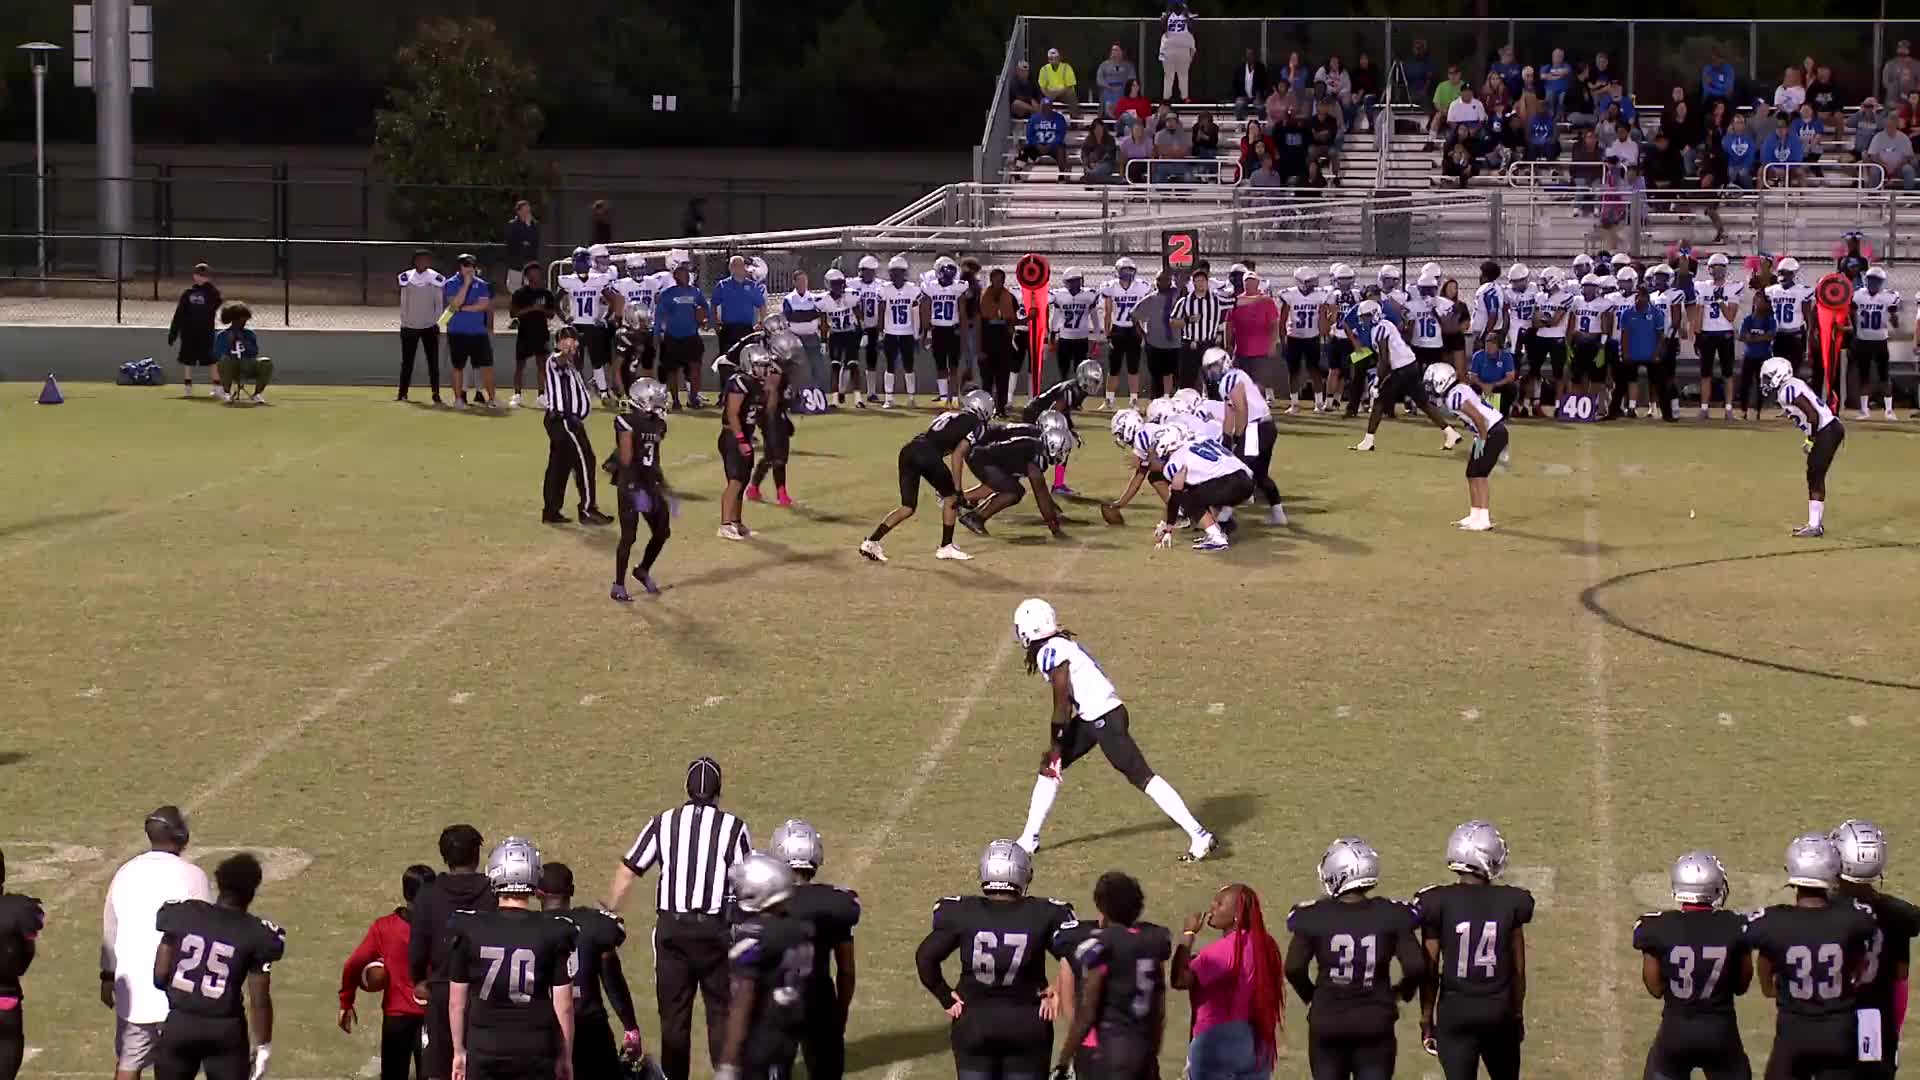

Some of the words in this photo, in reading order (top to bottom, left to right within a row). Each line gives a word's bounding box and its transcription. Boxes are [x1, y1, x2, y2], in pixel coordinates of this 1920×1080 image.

[1168, 234, 1193, 263] 2
[576, 297, 593, 317] 14
[891, 305, 908, 325] 15
[933, 301, 954, 320] 20
[1709, 302, 1720, 319] 3
[1063, 310, 1085, 329] 27
[1295, 311, 1313, 329] 31
[1418, 318, 1437, 338] 16
[1579, 316, 1591, 332] 9
[802, 388, 826, 411] 30
[1563, 395, 1592, 419] 40
[642, 443, 655, 467] 3
[972, 931, 1028, 986] 67
[1329, 934, 1377, 986] 31
[1455, 921, 1497, 978] 14
[171, 933, 235, 999] 25
[479, 945, 536, 1003] 70
[1669, 945, 1728, 1000] 37
[1786, 942, 1844, 1000] 33
